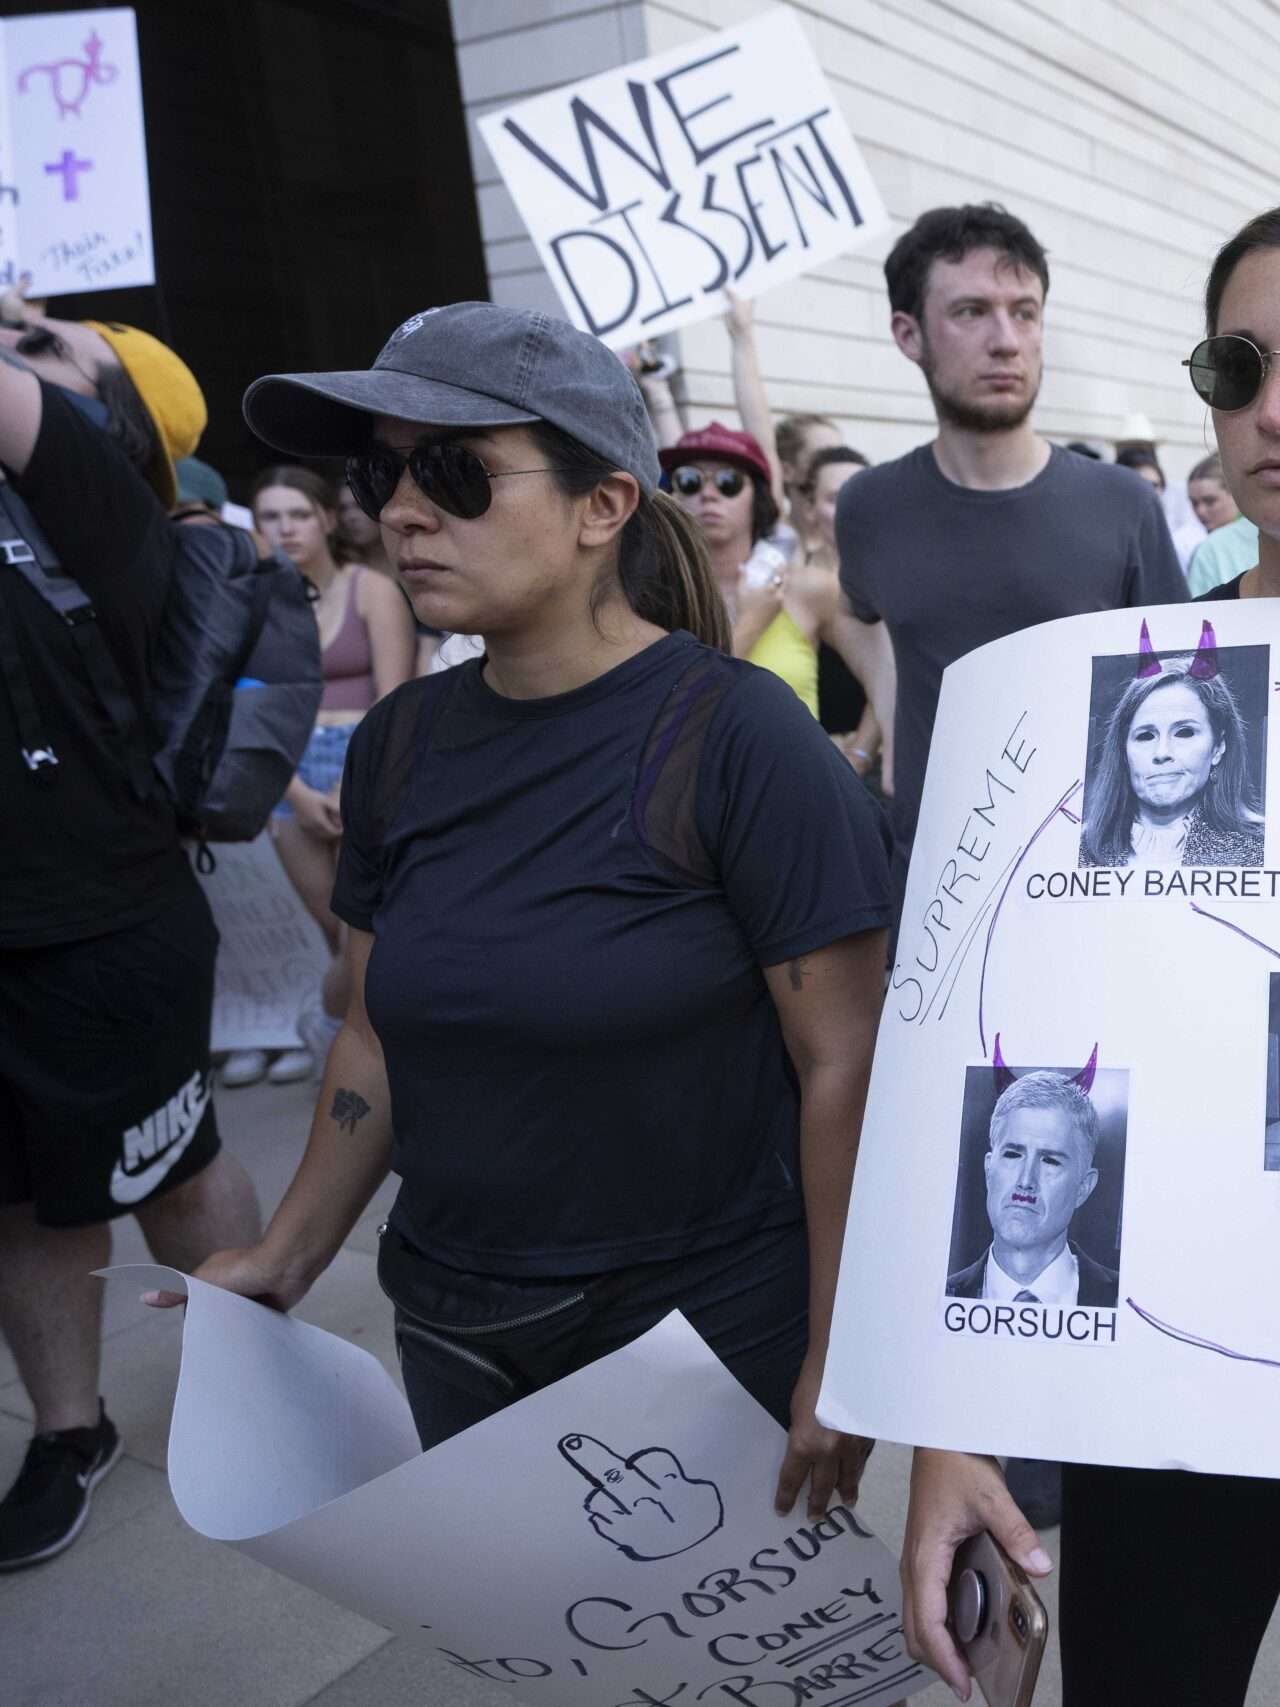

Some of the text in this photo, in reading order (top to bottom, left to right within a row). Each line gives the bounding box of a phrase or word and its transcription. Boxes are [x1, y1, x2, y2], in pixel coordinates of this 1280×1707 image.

[502, 44, 774, 212] WE
[550, 107, 864, 338] DISSENT
[893, 710, 1037, 1022] SUPREME
[1026, 869, 1135, 899] CONEY
[122, 1069, 203, 1173] NIKE
[944, 1302, 1117, 1342] GORSUCH
[696, 1624, 906, 1707] BARRE
[707, 1576, 885, 1667] CONEY
